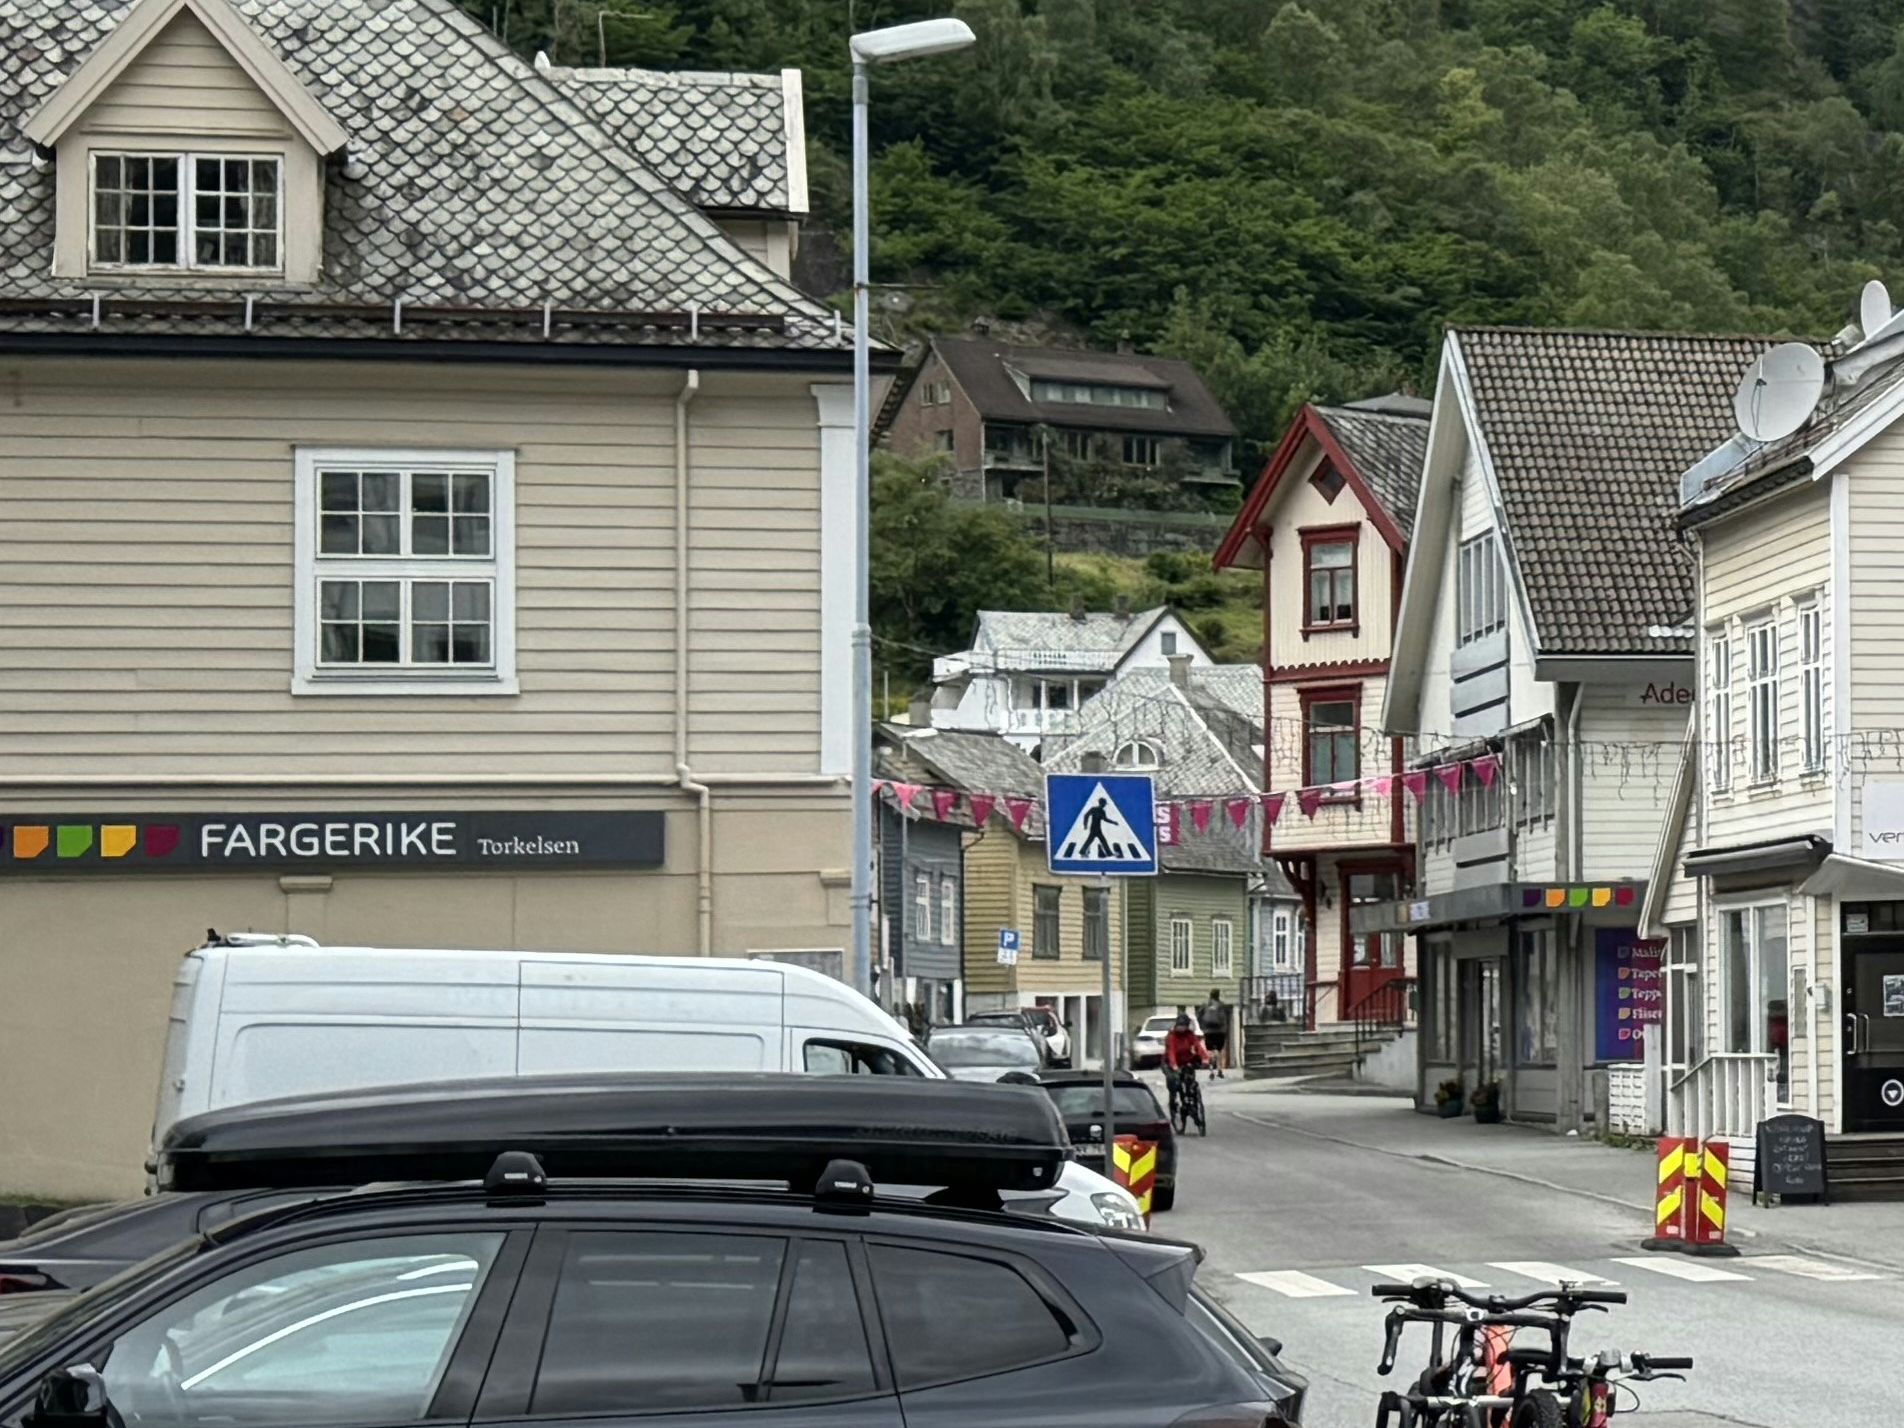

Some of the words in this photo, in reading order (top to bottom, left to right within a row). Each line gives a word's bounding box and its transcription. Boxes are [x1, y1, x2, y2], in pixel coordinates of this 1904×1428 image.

[201, 822, 457, 857] FARGERIKE
[477, 836, 580, 855] Torkelsen
[1003, 932, 1015, 947] P
